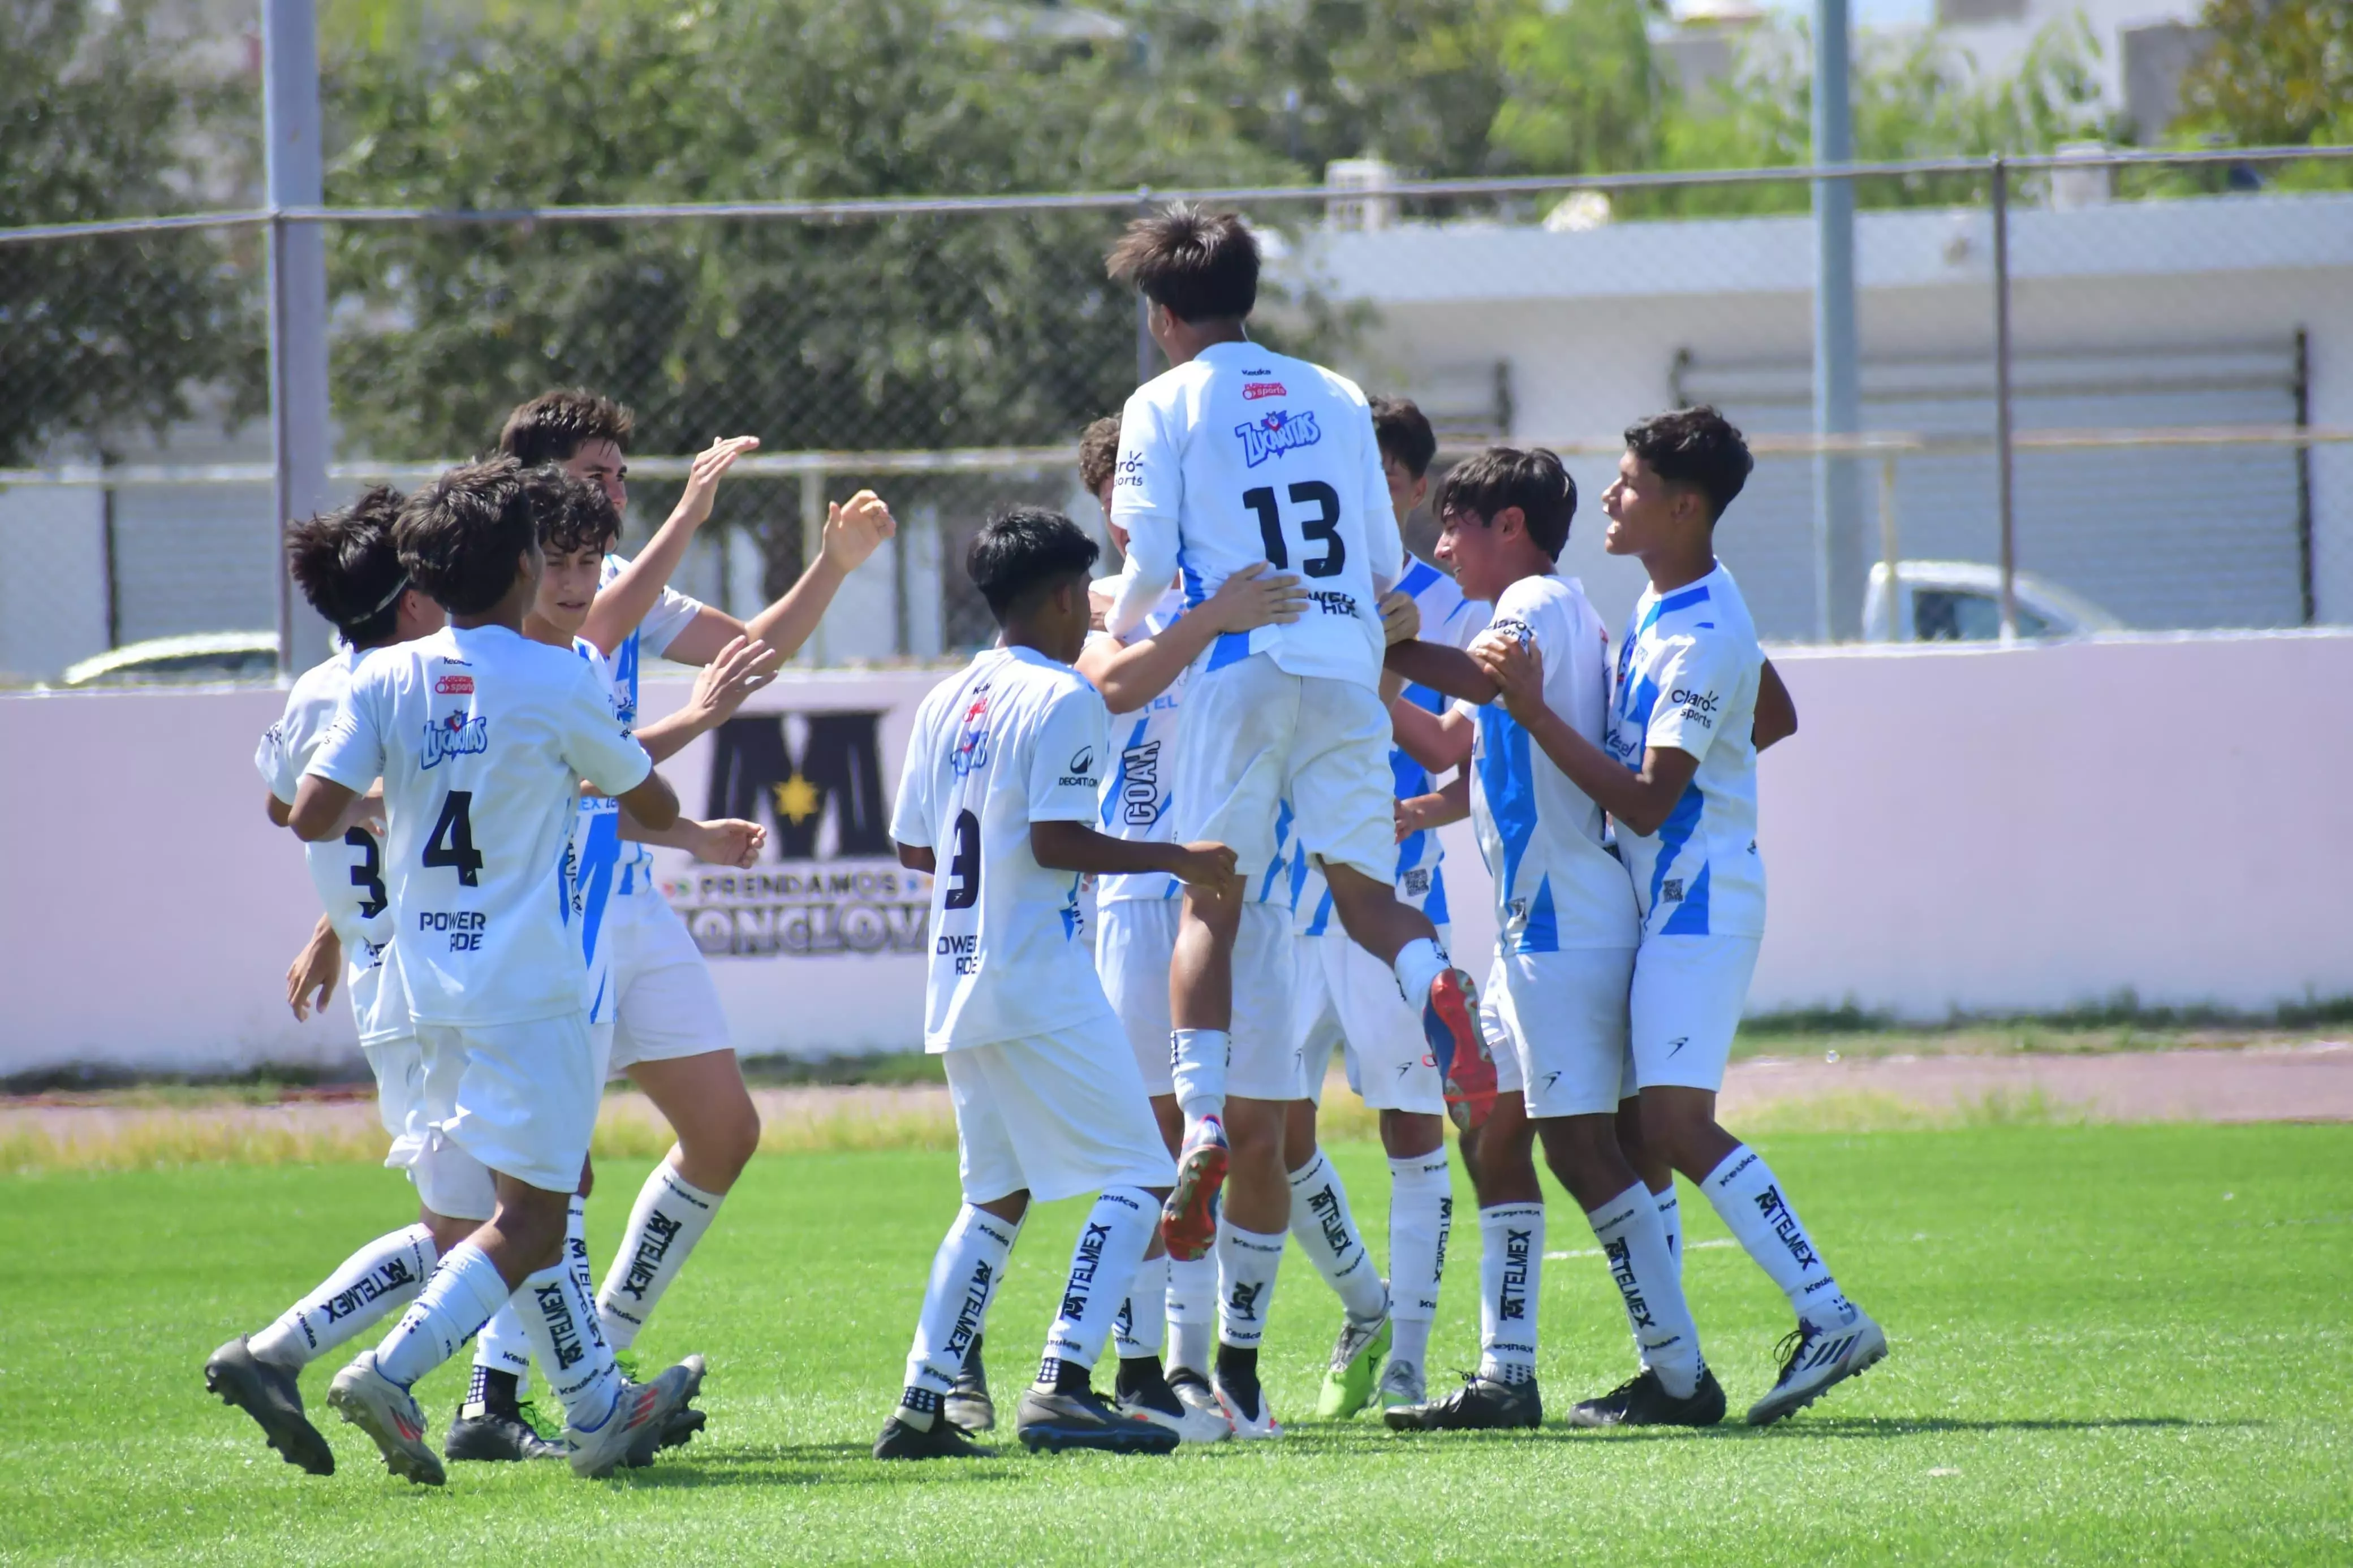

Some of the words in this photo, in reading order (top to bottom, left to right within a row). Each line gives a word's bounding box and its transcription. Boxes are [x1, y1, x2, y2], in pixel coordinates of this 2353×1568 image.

[1242, 480, 1346, 578] 13
[1671, 689, 1714, 711] Claro
[1680, 708, 1712, 729] sports
[345, 826, 388, 919] 3
[422, 790, 484, 888] 4
[420, 912, 486, 931] POWER
[686, 905, 930, 957] ONCLOV
[1068, 1222, 1112, 1293] TELMEX
[1502, 1228, 1532, 1296] TELMEX
[1771, 1208, 1818, 1272] TELMEX
[318, 1272, 390, 1324] TELMEX
[534, 1282, 577, 1349] TELMEX
[942, 1284, 989, 1360] TELMEX
